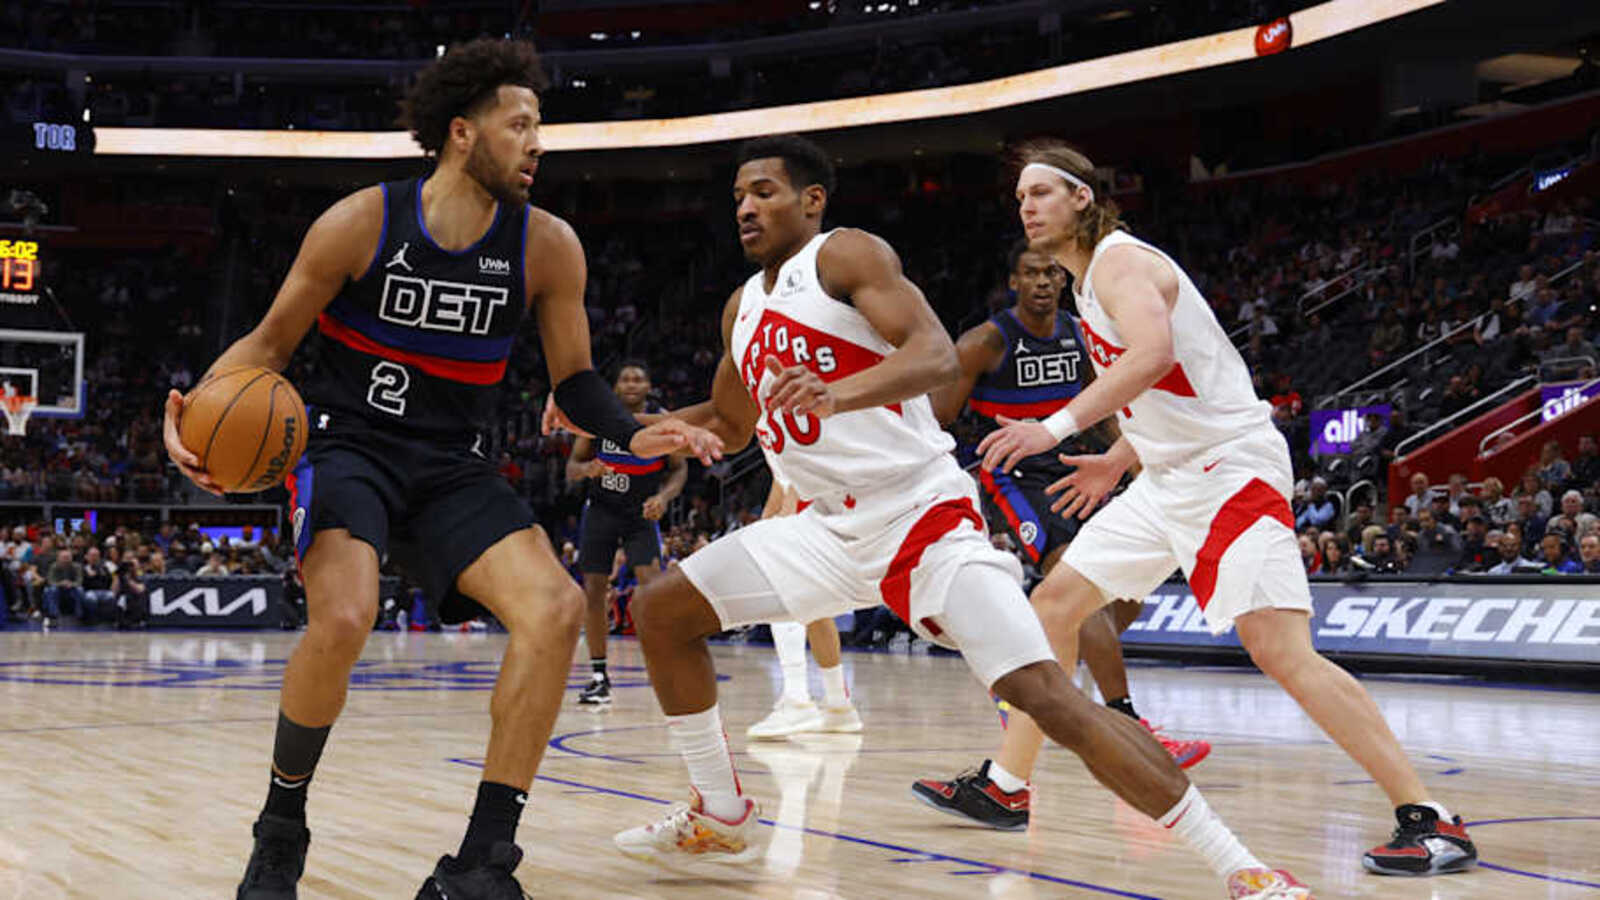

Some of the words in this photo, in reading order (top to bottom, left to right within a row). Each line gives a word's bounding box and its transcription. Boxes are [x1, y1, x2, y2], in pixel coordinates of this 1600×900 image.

[33, 122, 76, 151] TOR
[0, 240, 39, 260] 6:02
[479, 256, 510, 272] UWM
[3, 259, 33, 290] 13
[379, 274, 508, 334] DET
[744, 322, 837, 388] APTORS
[1016, 351, 1081, 386] DET
[368, 361, 409, 415] 2
[150, 587, 267, 616] KIA
[1317, 597, 1600, 644] SKECHE
